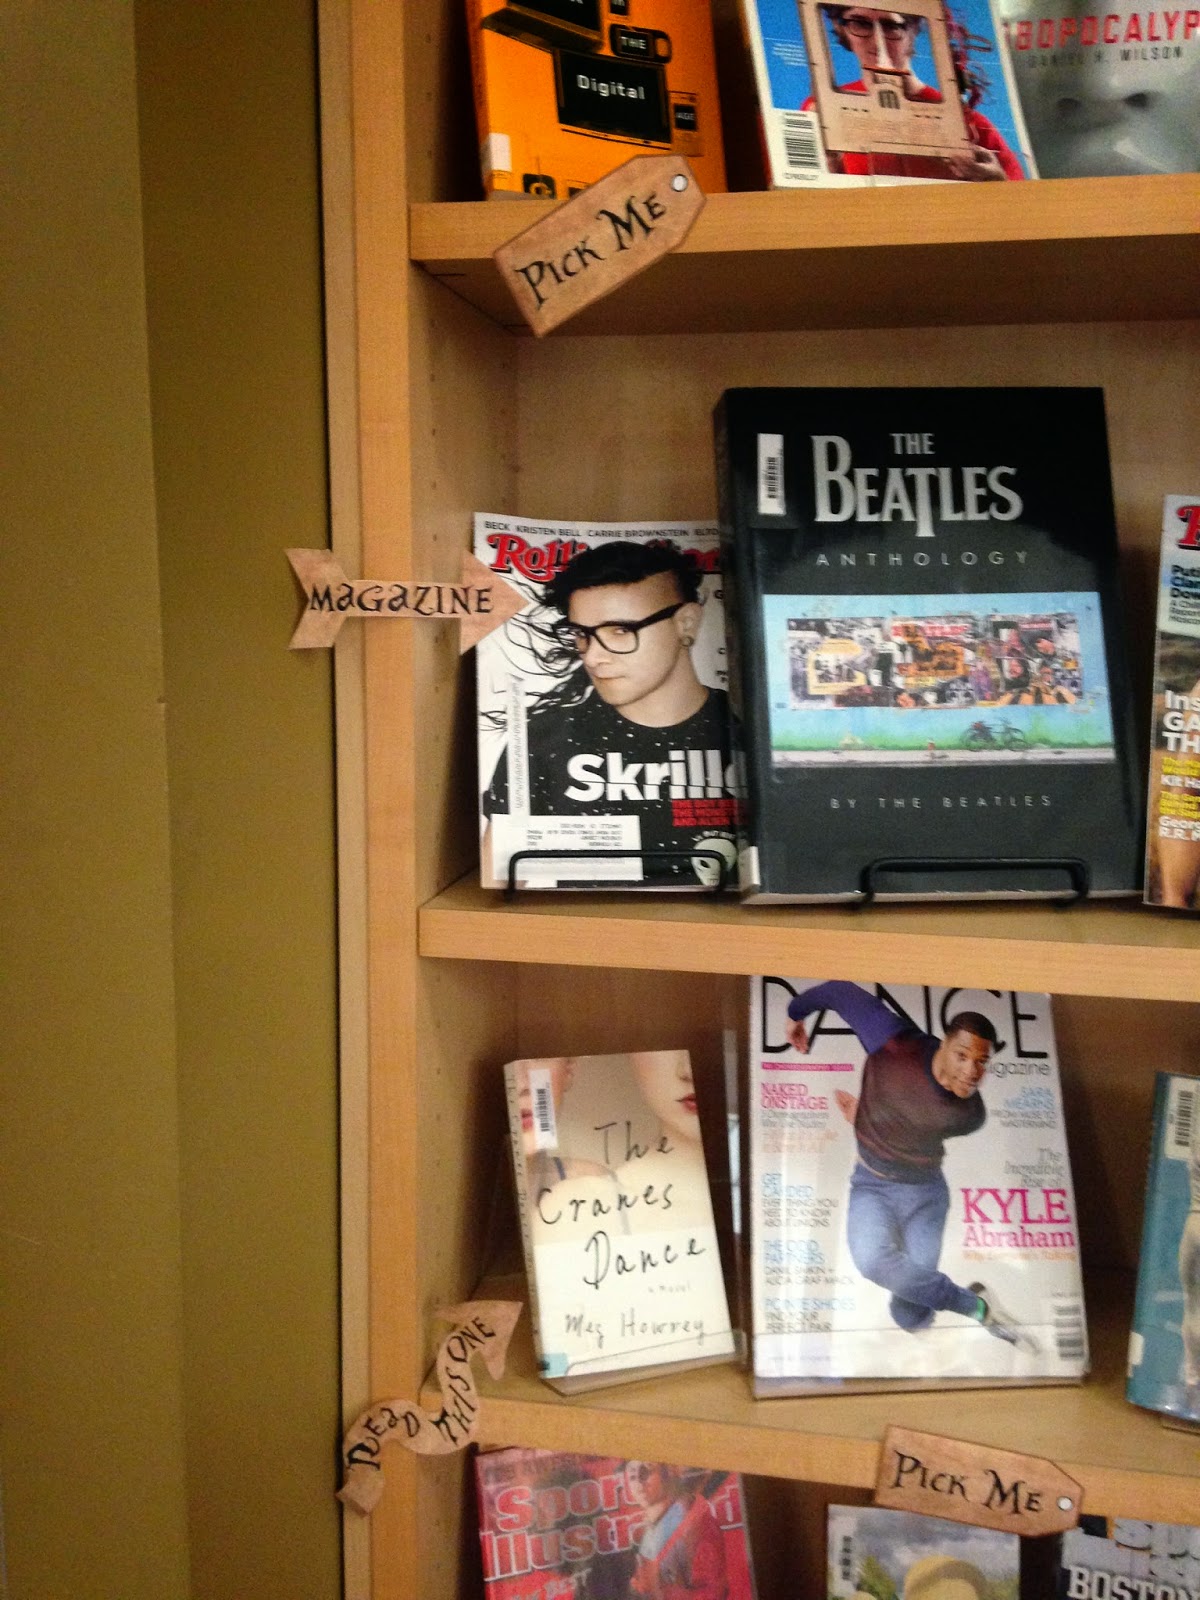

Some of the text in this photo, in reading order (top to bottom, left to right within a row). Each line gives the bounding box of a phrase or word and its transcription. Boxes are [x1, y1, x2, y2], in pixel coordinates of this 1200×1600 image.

[621, 35, 647, 50] THE
[1002, 9, 1200, 52] BOPOCALYP
[1119, 45, 1184, 62] WILSON
[576, 73, 646, 100] Digital
[891, 432, 936, 456] THE
[810, 434, 1024, 538] BEATLES
[485, 520, 511, 532] BECK
[516, 524, 557, 536] KRISTEN
[559, 525, 581, 537] BELL
[586, 528, 622, 538] CARRIE
[625, 528, 690, 538] BROWNSTEIN
[486, 533, 590, 584] Roll
[815, 550, 1028, 567] ANTHOLOGY
[830, 794, 1052, 810] BY THE BEATLES
[987, 1062, 1052, 1079] gazine
[761, 1082, 809, 1097] NAKED
[761, 1096, 829, 1111] ONSTAGE
[594, 1120, 674, 1165] The
[537, 1182, 674, 1225] Cranes
[960, 1187, 1072, 1224] KYLE
[963, 1224, 1076, 1249] Abraham
[584, 1230, 707, 1290] Dance
[446, 1316, 497, 1363] ONE
[565, 1308, 706, 1349] Meg Howrey
[428, 1366, 477, 1446] THIS
[495, 1472, 645, 1532] Spor
